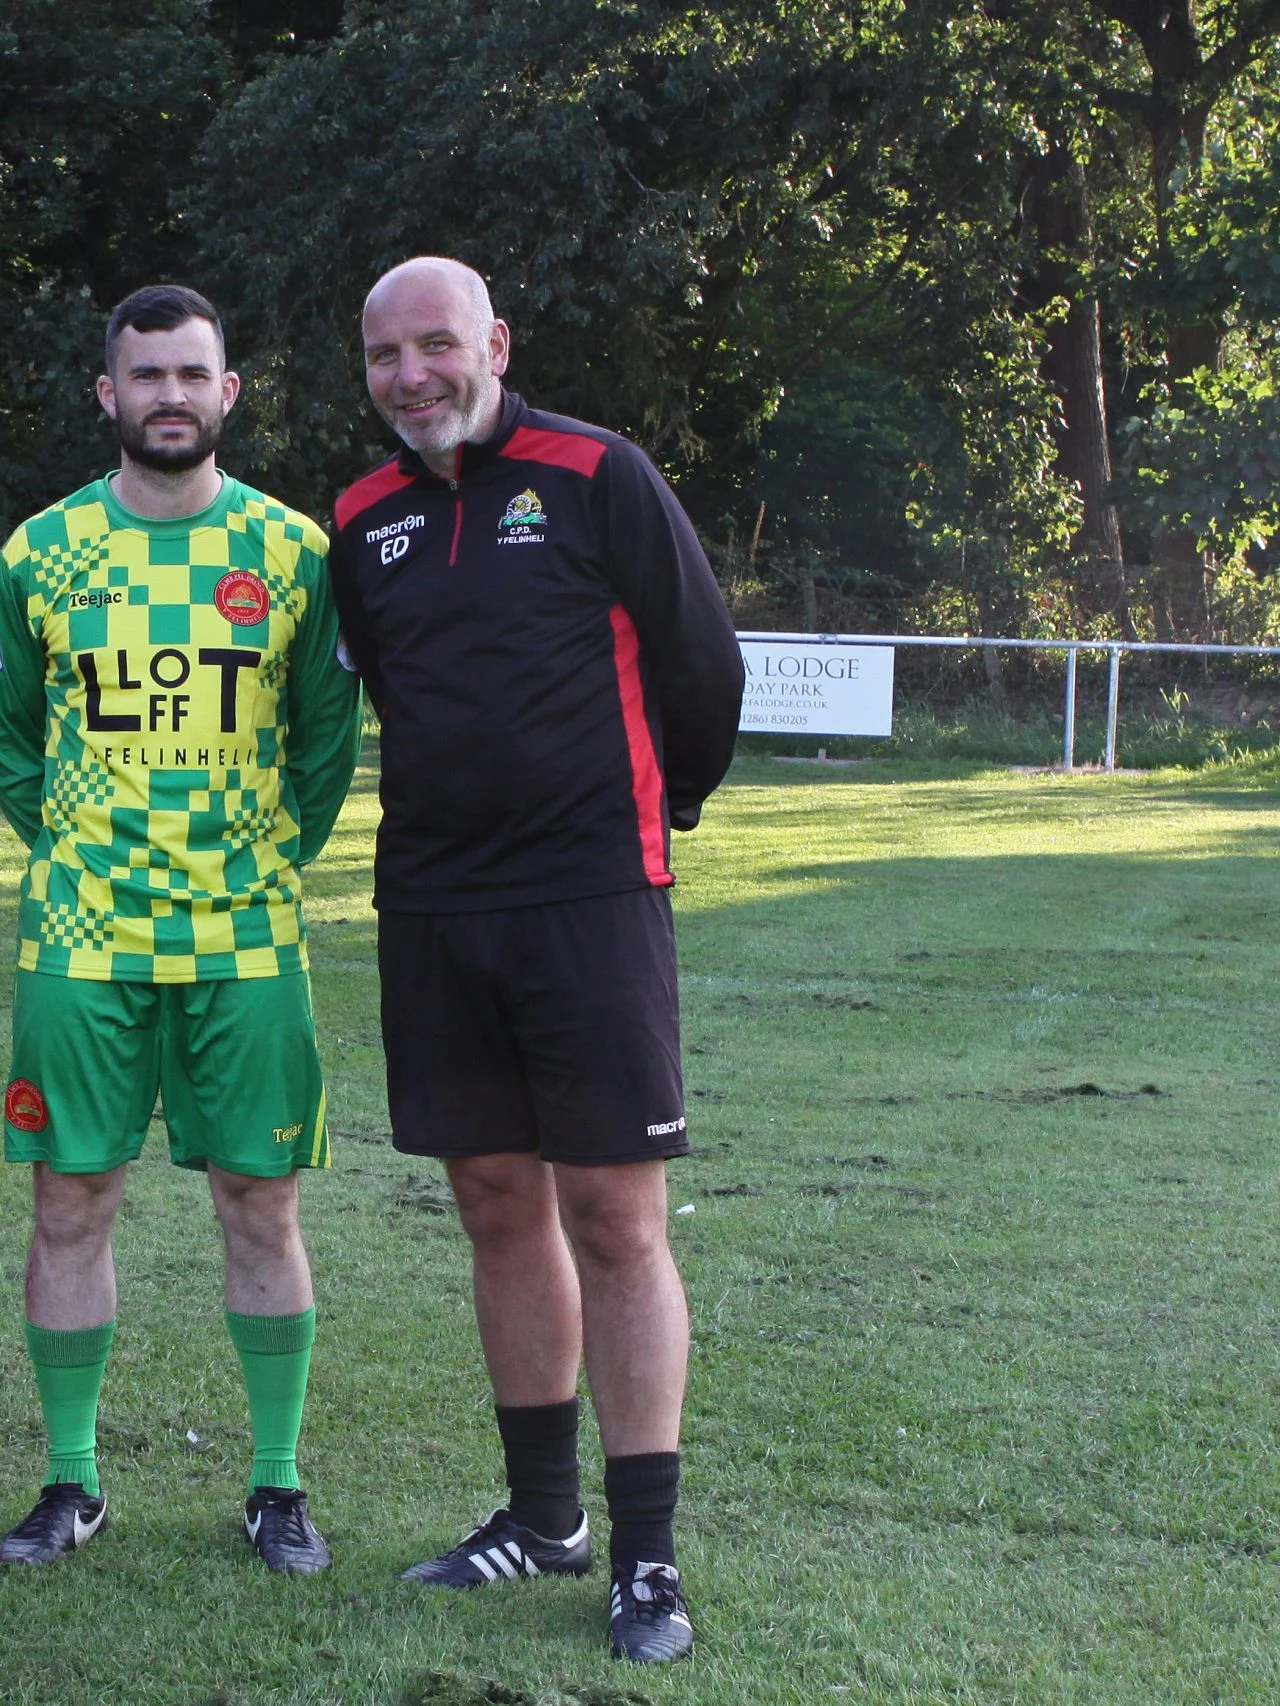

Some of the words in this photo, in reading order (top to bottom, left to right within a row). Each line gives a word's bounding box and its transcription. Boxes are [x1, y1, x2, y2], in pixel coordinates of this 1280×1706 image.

[497, 537, 503, 545] Y
[504, 534, 545, 544] FELINHELI
[380, 535, 410, 565] ED
[70, 592, 123, 608] Teejac
[764, 656, 860, 680] LODGE
[781, 683, 824, 697] PARK
[770, 714, 809, 726] 830205
[104, 747, 252, 766] FELINHELI
